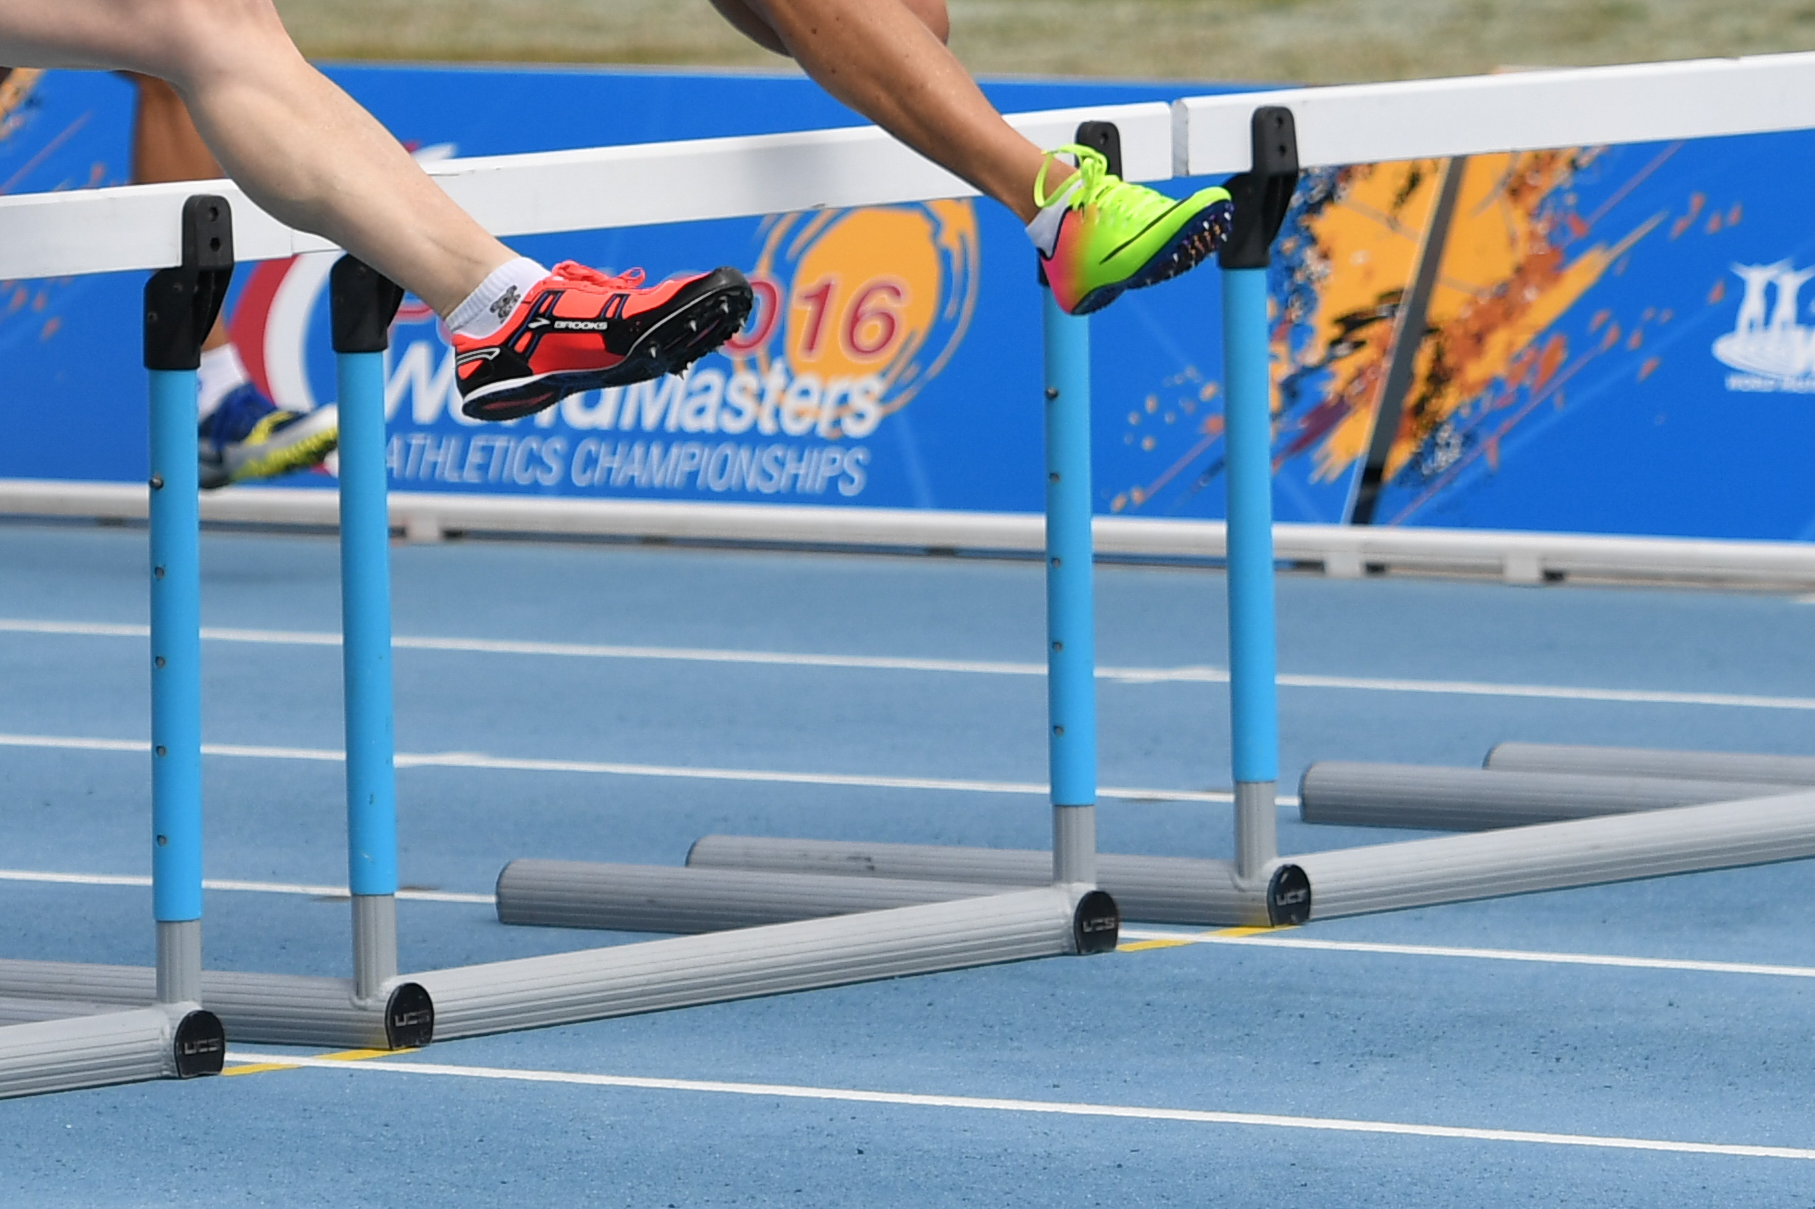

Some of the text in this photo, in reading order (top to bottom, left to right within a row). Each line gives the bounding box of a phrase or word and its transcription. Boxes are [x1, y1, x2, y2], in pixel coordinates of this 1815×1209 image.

[554, 321, 608, 330] BROOKS
[386, 435, 871, 497] ATHLETICS CHAMPIONSHIPS
